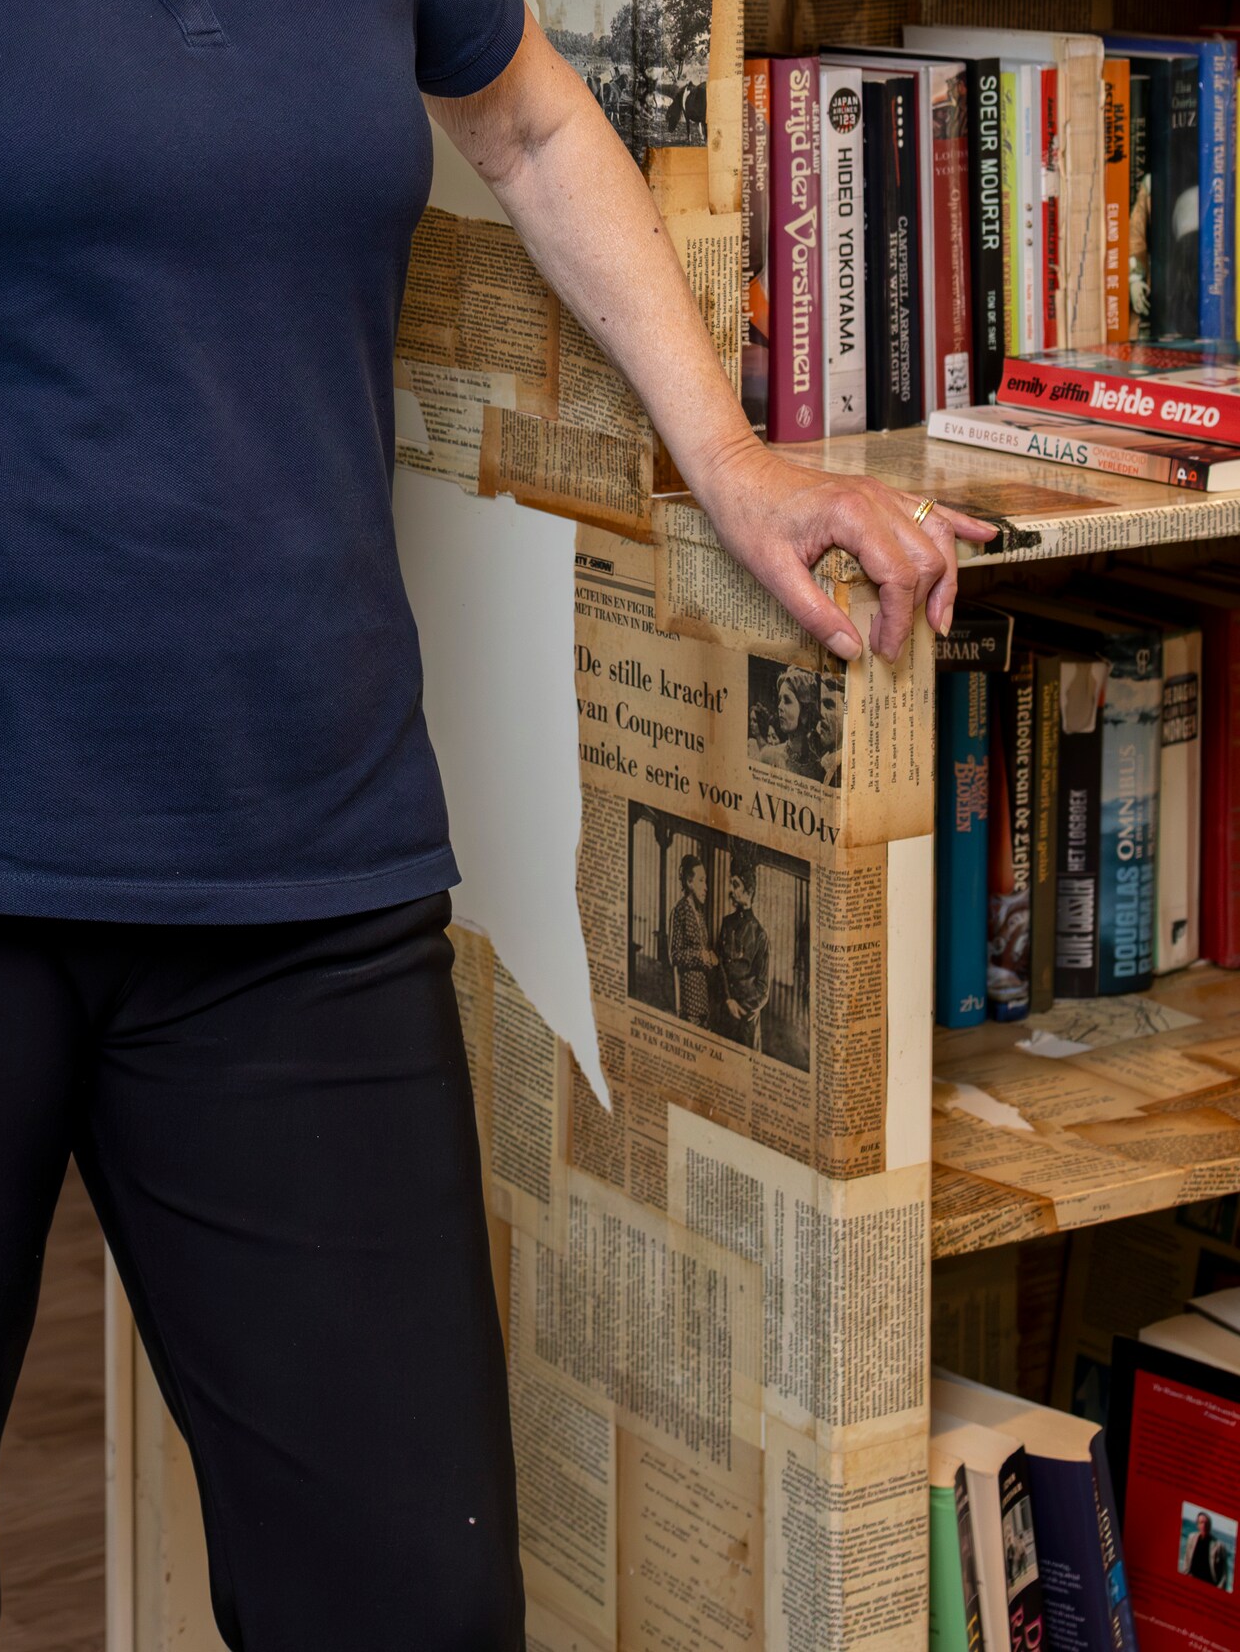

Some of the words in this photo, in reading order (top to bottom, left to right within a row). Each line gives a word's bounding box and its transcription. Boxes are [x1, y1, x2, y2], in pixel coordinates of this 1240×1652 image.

[785, 69, 812, 154] Strijd
[832, 96, 859, 108] JAPAN
[839, 114, 856, 126] 123
[978, 75, 999, 151] SOEUR
[790, 156, 812, 211] der
[837, 147, 853, 218] HIDEO
[980, 157, 1001, 251] MOURIR
[783, 205, 818, 395] Vorstinnen
[838, 228, 855, 356] YOKOYAMA
[1007, 376, 1048, 398] emily
[1050, 382, 1090, 403] giffin
[1089, 380, 1155, 417] liefde
[1160, 399, 1220, 429] enzo
[944, 421, 965, 437] EVA
[968, 426, 1019, 447] BURGERS
[1097, 459, 1140, 476] VERLEDEN
[575, 586, 613, 607] ACTEURS
[594, 606, 629, 628] TRANEN
[609, 657, 653, 695] stille
[577, 698, 609, 725] van
[615, 701, 706, 755] Couperus
[579, 741, 639, 779] unieke
[645, 762, 691, 795] serie
[698, 782, 744, 813] voor
[1116, 743, 1138, 862] OMNIBUS
[1113, 865, 1141, 978] DOUGLAS
